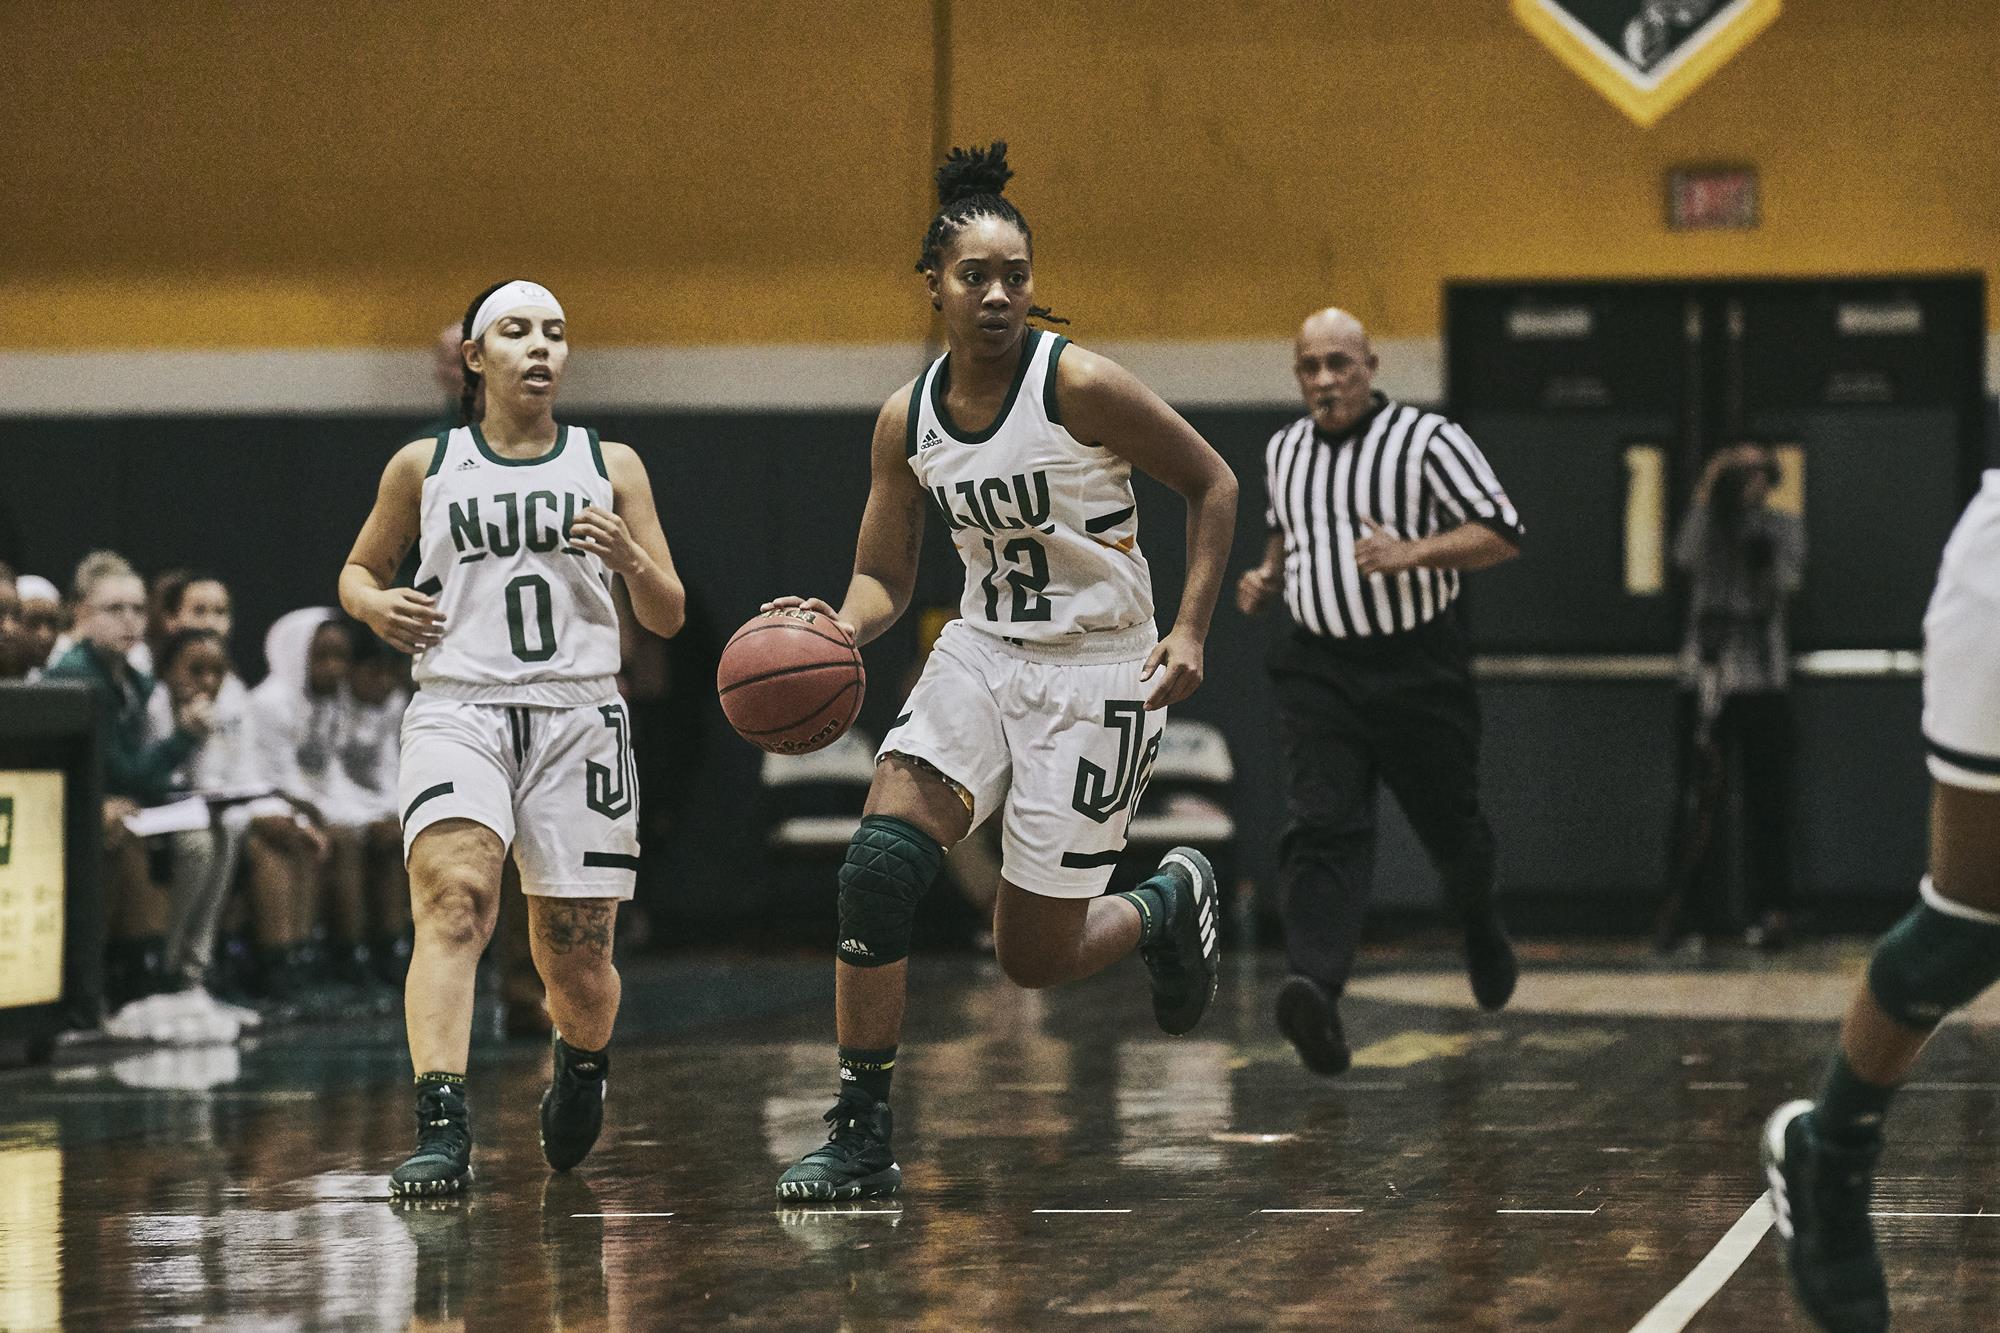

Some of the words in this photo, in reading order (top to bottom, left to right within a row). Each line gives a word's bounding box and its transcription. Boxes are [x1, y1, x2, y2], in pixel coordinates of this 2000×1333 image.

[920, 438, 943, 450] adidas
[505, 574, 558, 663] 0
[981, 536, 1052, 622] 12
